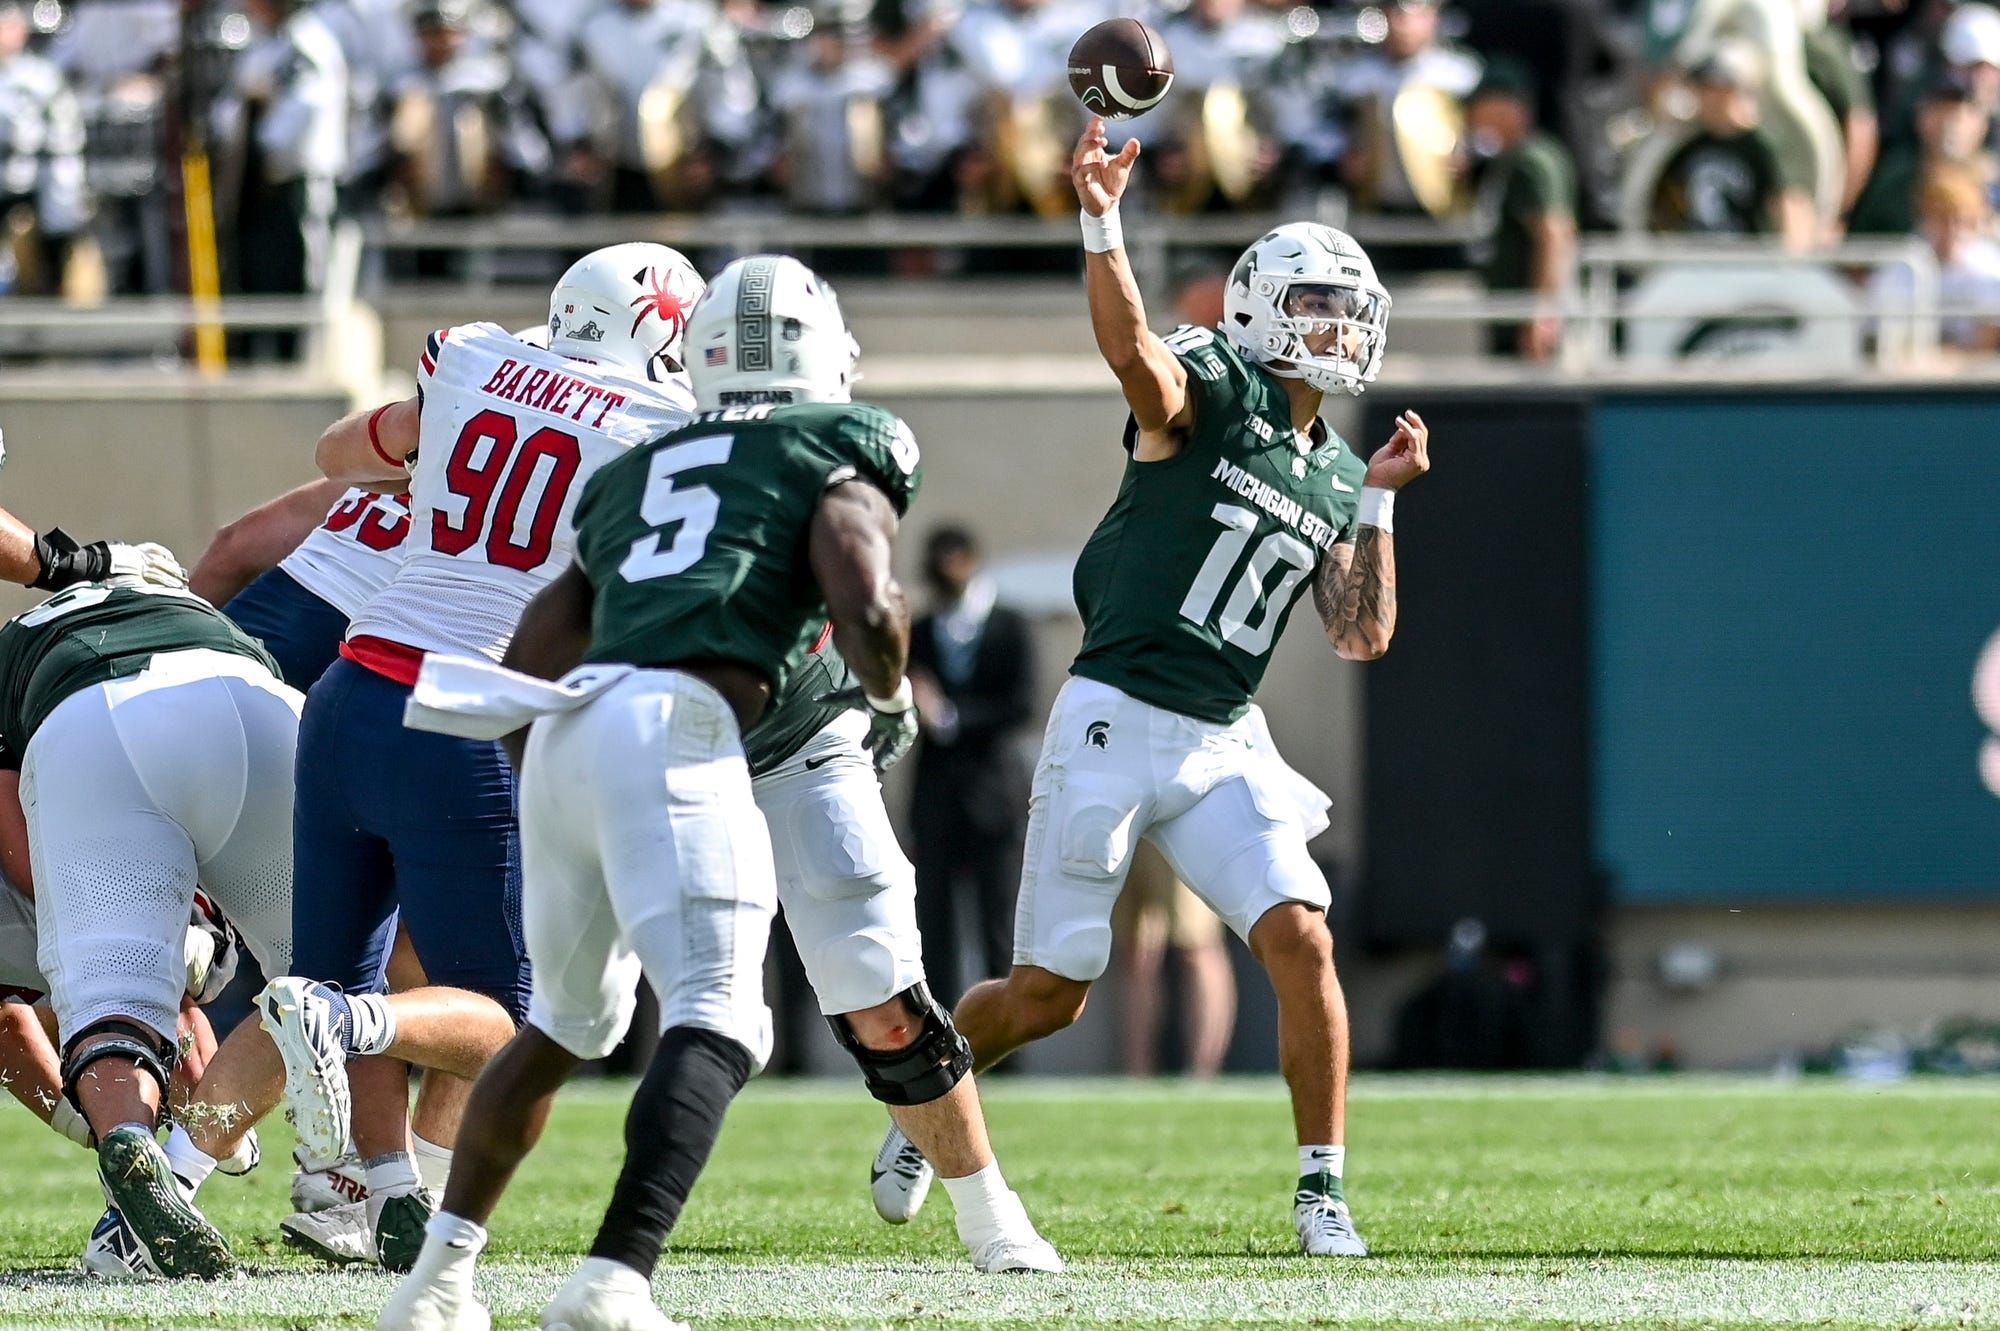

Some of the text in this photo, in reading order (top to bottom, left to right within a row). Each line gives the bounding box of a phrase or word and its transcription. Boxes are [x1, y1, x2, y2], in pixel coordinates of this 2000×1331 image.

[564, 304, 575, 314] 90
[481, 358, 626, 428] BARNETT
[719, 390, 793, 406] SPARTANS
[431, 409, 582, 572] 90
[618, 434, 734, 583] 5
[1210, 456, 1340, 552] MICHIGAN STAT
[1179, 503, 1315, 657] 10
